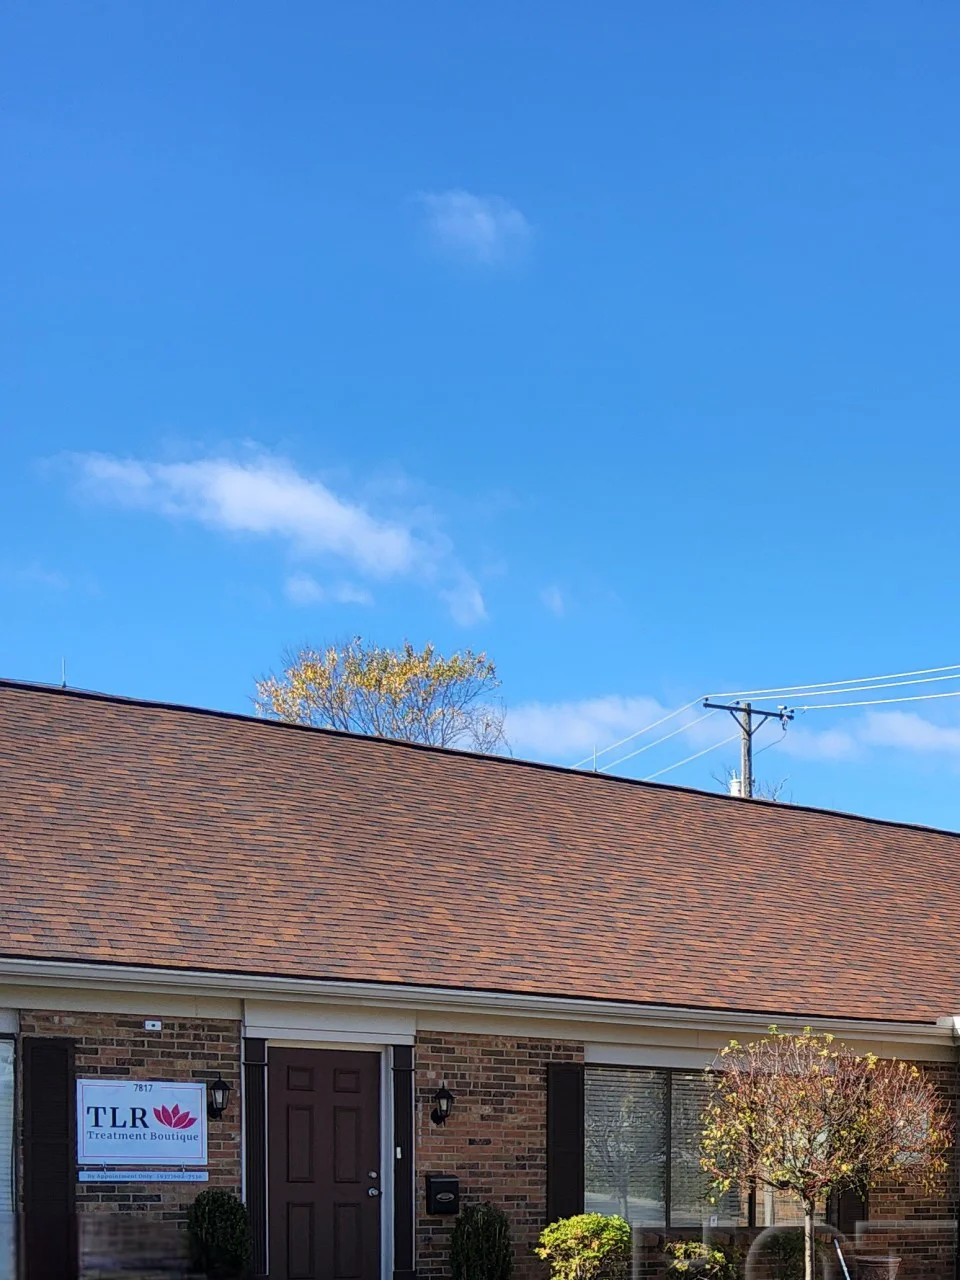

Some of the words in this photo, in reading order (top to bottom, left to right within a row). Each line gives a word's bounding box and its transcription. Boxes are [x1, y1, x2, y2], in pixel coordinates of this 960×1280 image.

[133, 1083, 153, 1093] 7817
[86, 1106, 150, 1129] TLR
[86, 1130, 147, 1141] Treatment
[150, 1131, 199, 1143] Boutique
